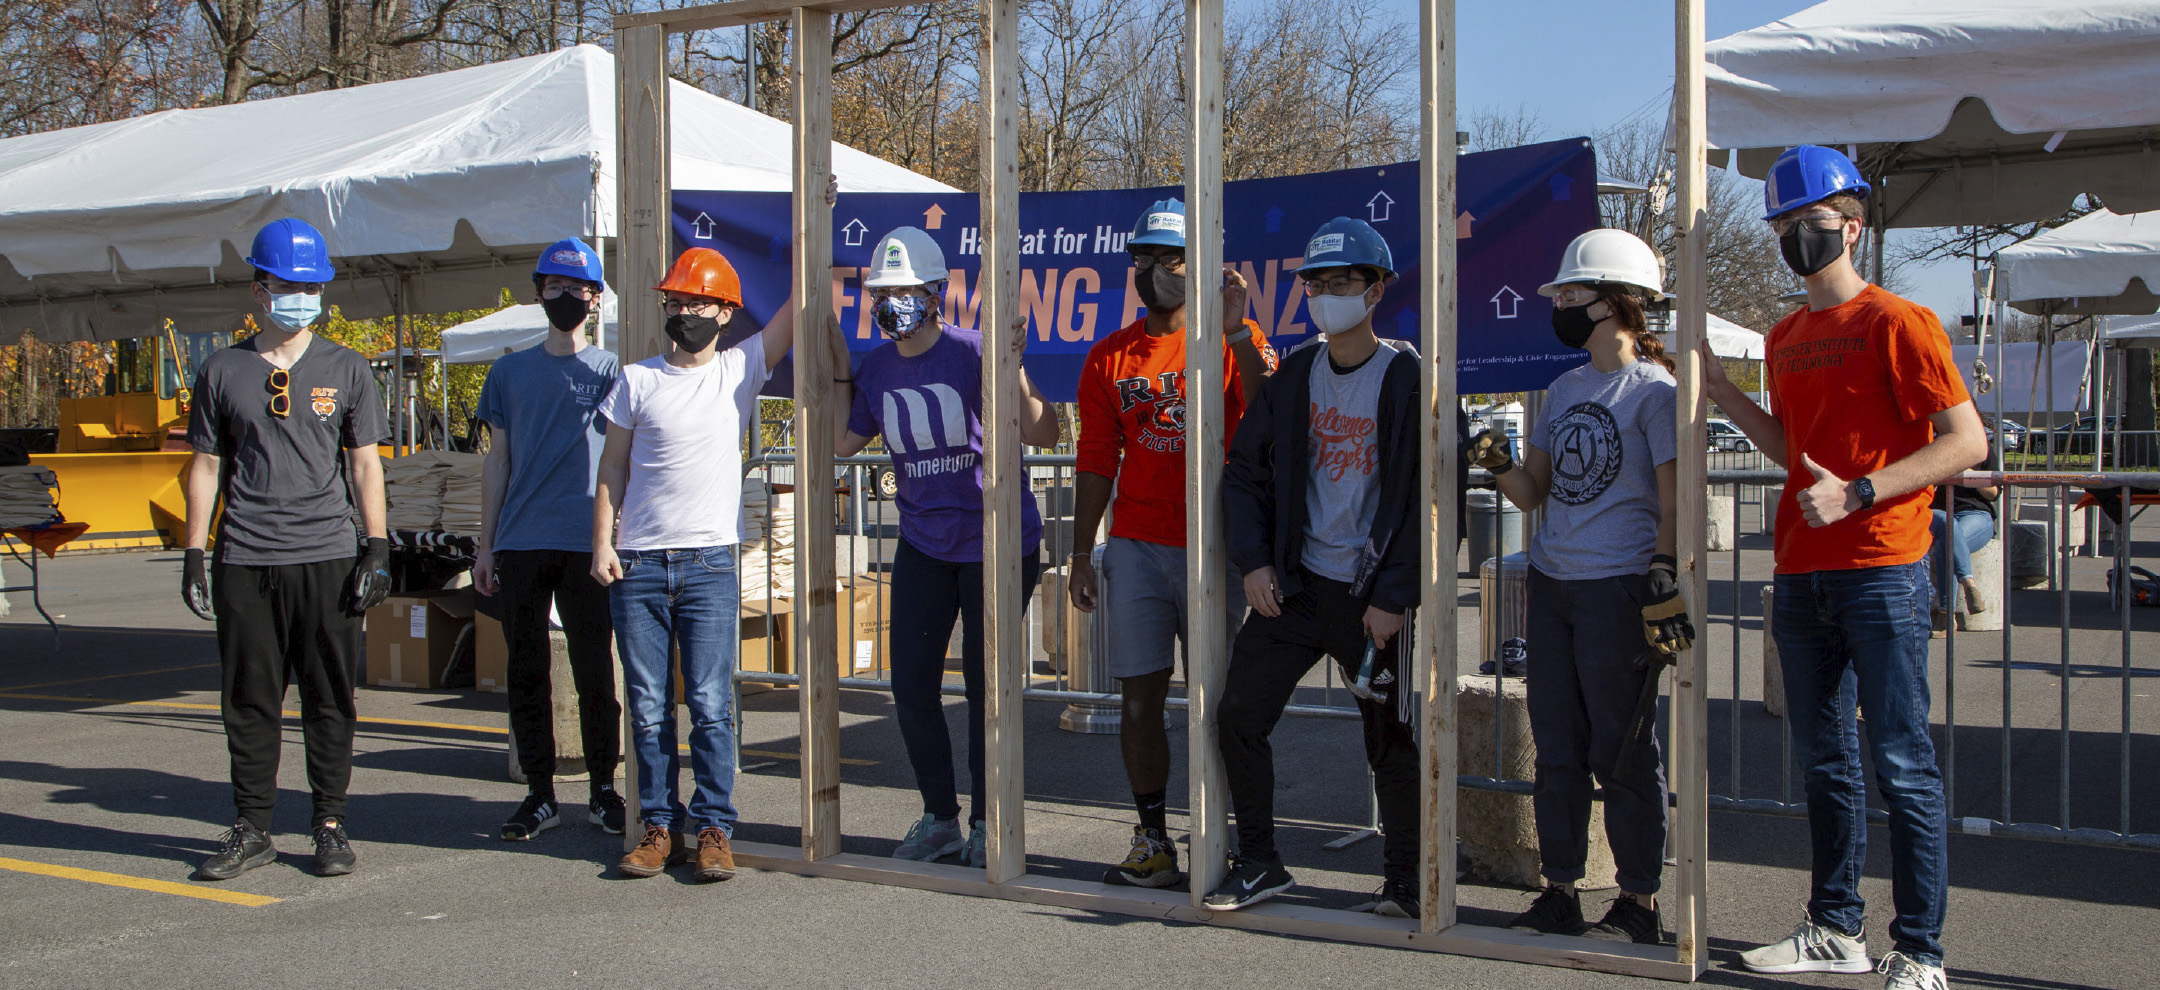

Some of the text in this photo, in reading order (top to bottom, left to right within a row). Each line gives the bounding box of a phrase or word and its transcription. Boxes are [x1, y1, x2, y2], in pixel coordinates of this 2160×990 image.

[1053, 226, 1087, 254] for
[1814, 338, 1867, 352] INSTITUTE
[1478, 355, 1517, 364] Leadership
[1544, 351, 1589, 361] Engagement
[1786, 353, 1845, 373] TECHNOLOGY
[311, 387, 339, 397] RIT
[576, 383, 600, 394] RIT
[1116, 369, 1186, 413] RI
[1138, 428, 1186, 452] TIGE
[1588, 455, 1606, 482] ARTS
